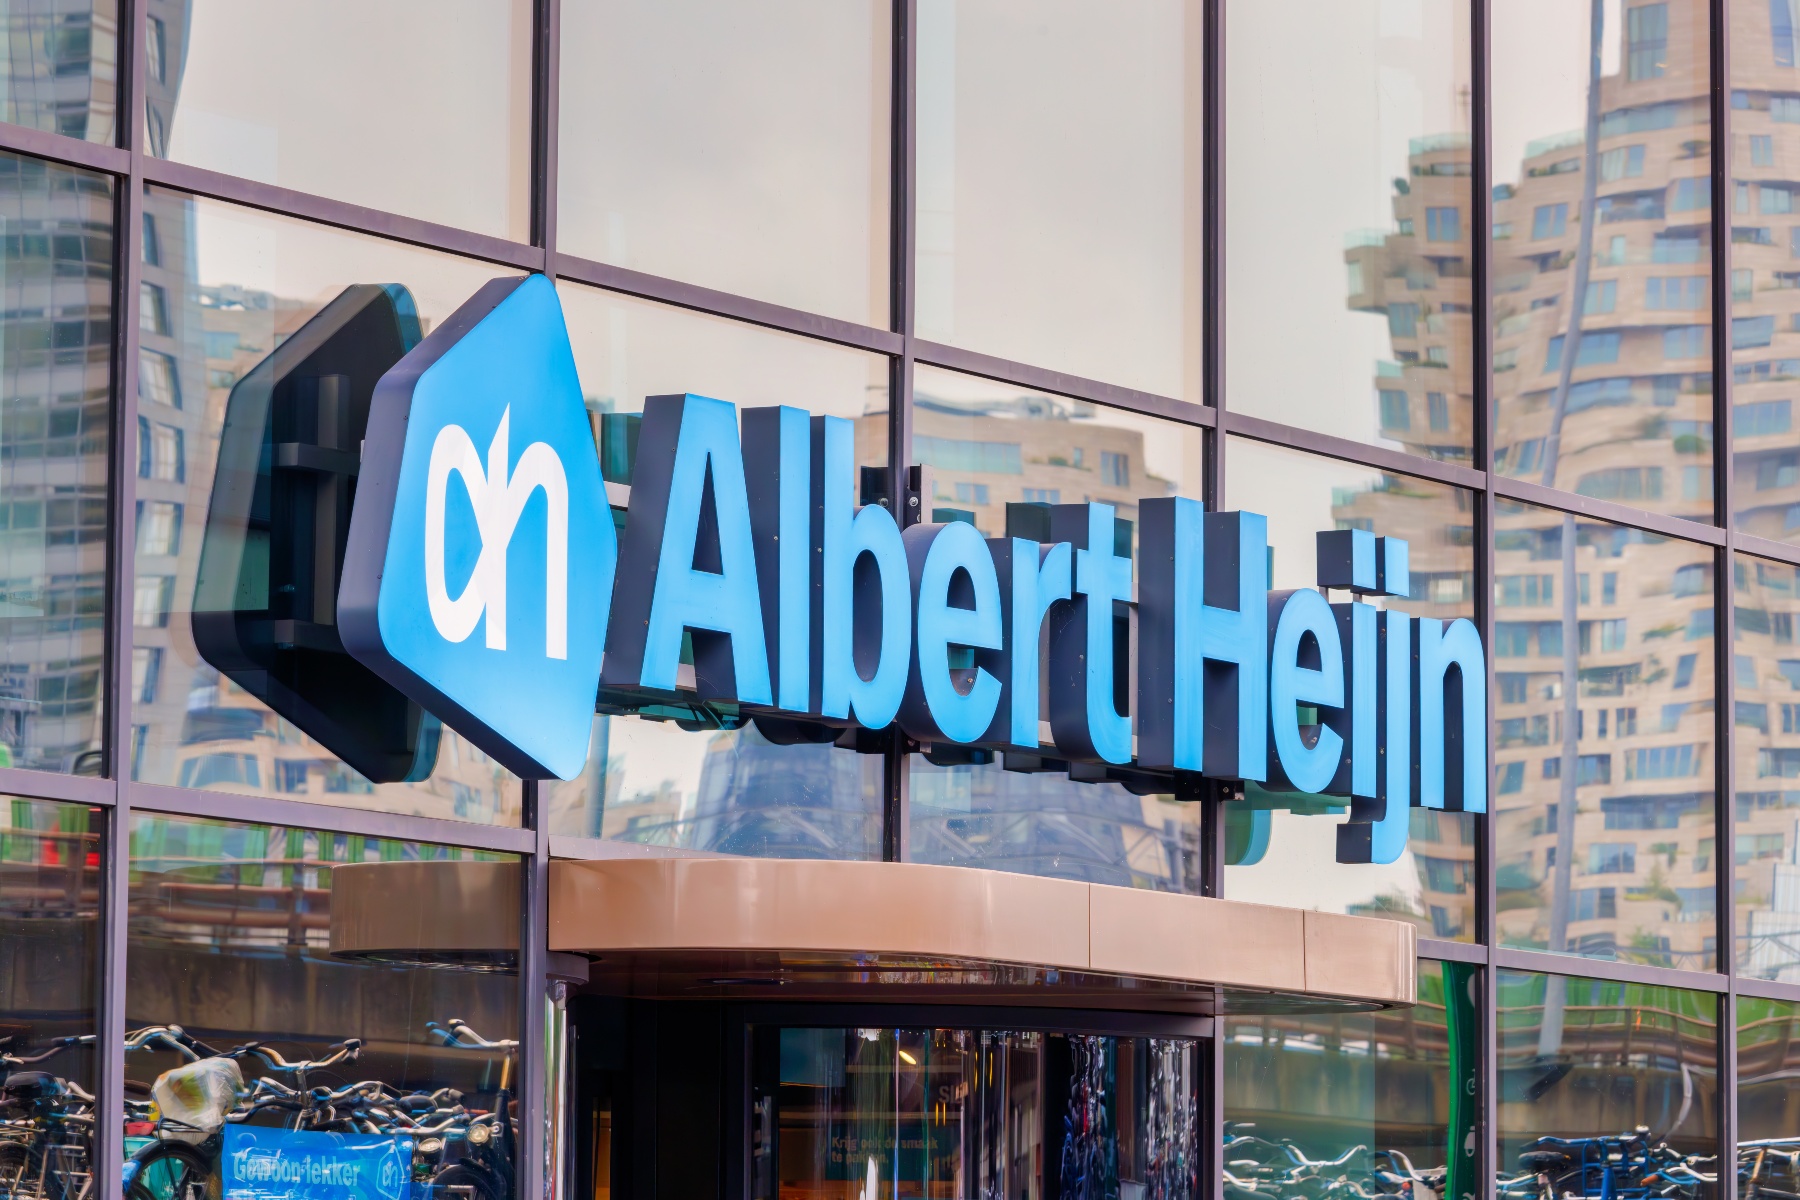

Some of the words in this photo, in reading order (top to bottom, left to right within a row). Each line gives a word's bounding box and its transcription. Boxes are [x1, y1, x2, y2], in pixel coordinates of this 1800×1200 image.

[640, 393, 1132, 764] Albert
[1174, 495, 1487, 865] Heijn
[233, 1153, 300, 1183] Gewoon
[306, 1154, 361, 1187] lekker
